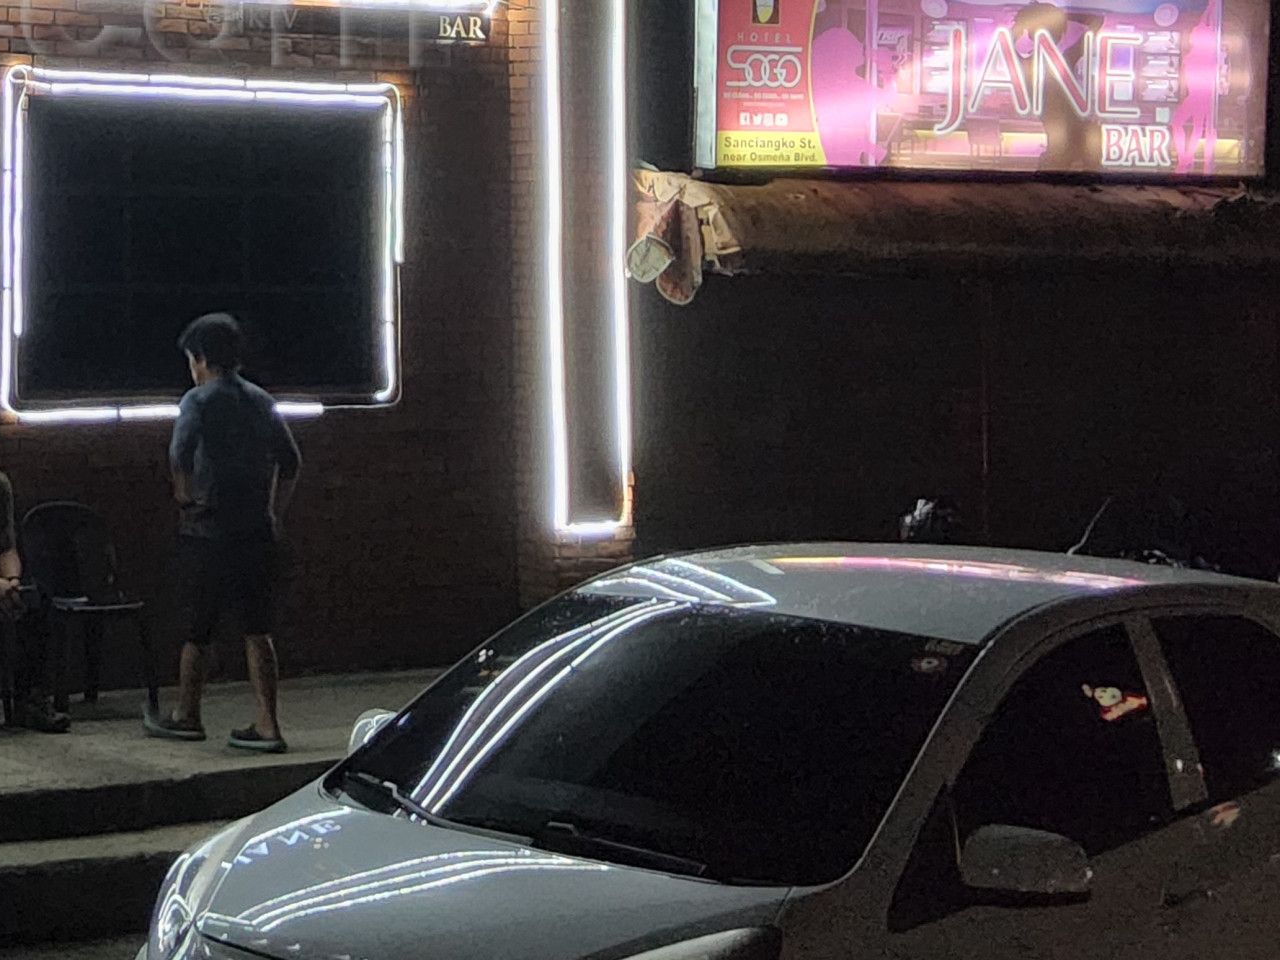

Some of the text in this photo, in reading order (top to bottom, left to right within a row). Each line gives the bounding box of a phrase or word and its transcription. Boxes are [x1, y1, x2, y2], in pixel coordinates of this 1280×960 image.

[439, 15, 487, 39] BAR
[737, 31, 792, 44] HOTEL
[726, 44, 803, 88] SOGO
[934, 26, 1142, 135] JANE
[724, 136, 816, 151] Sanciangko St.
[1101, 124, 1171, 166] BAR
[723, 153, 747, 162] near
